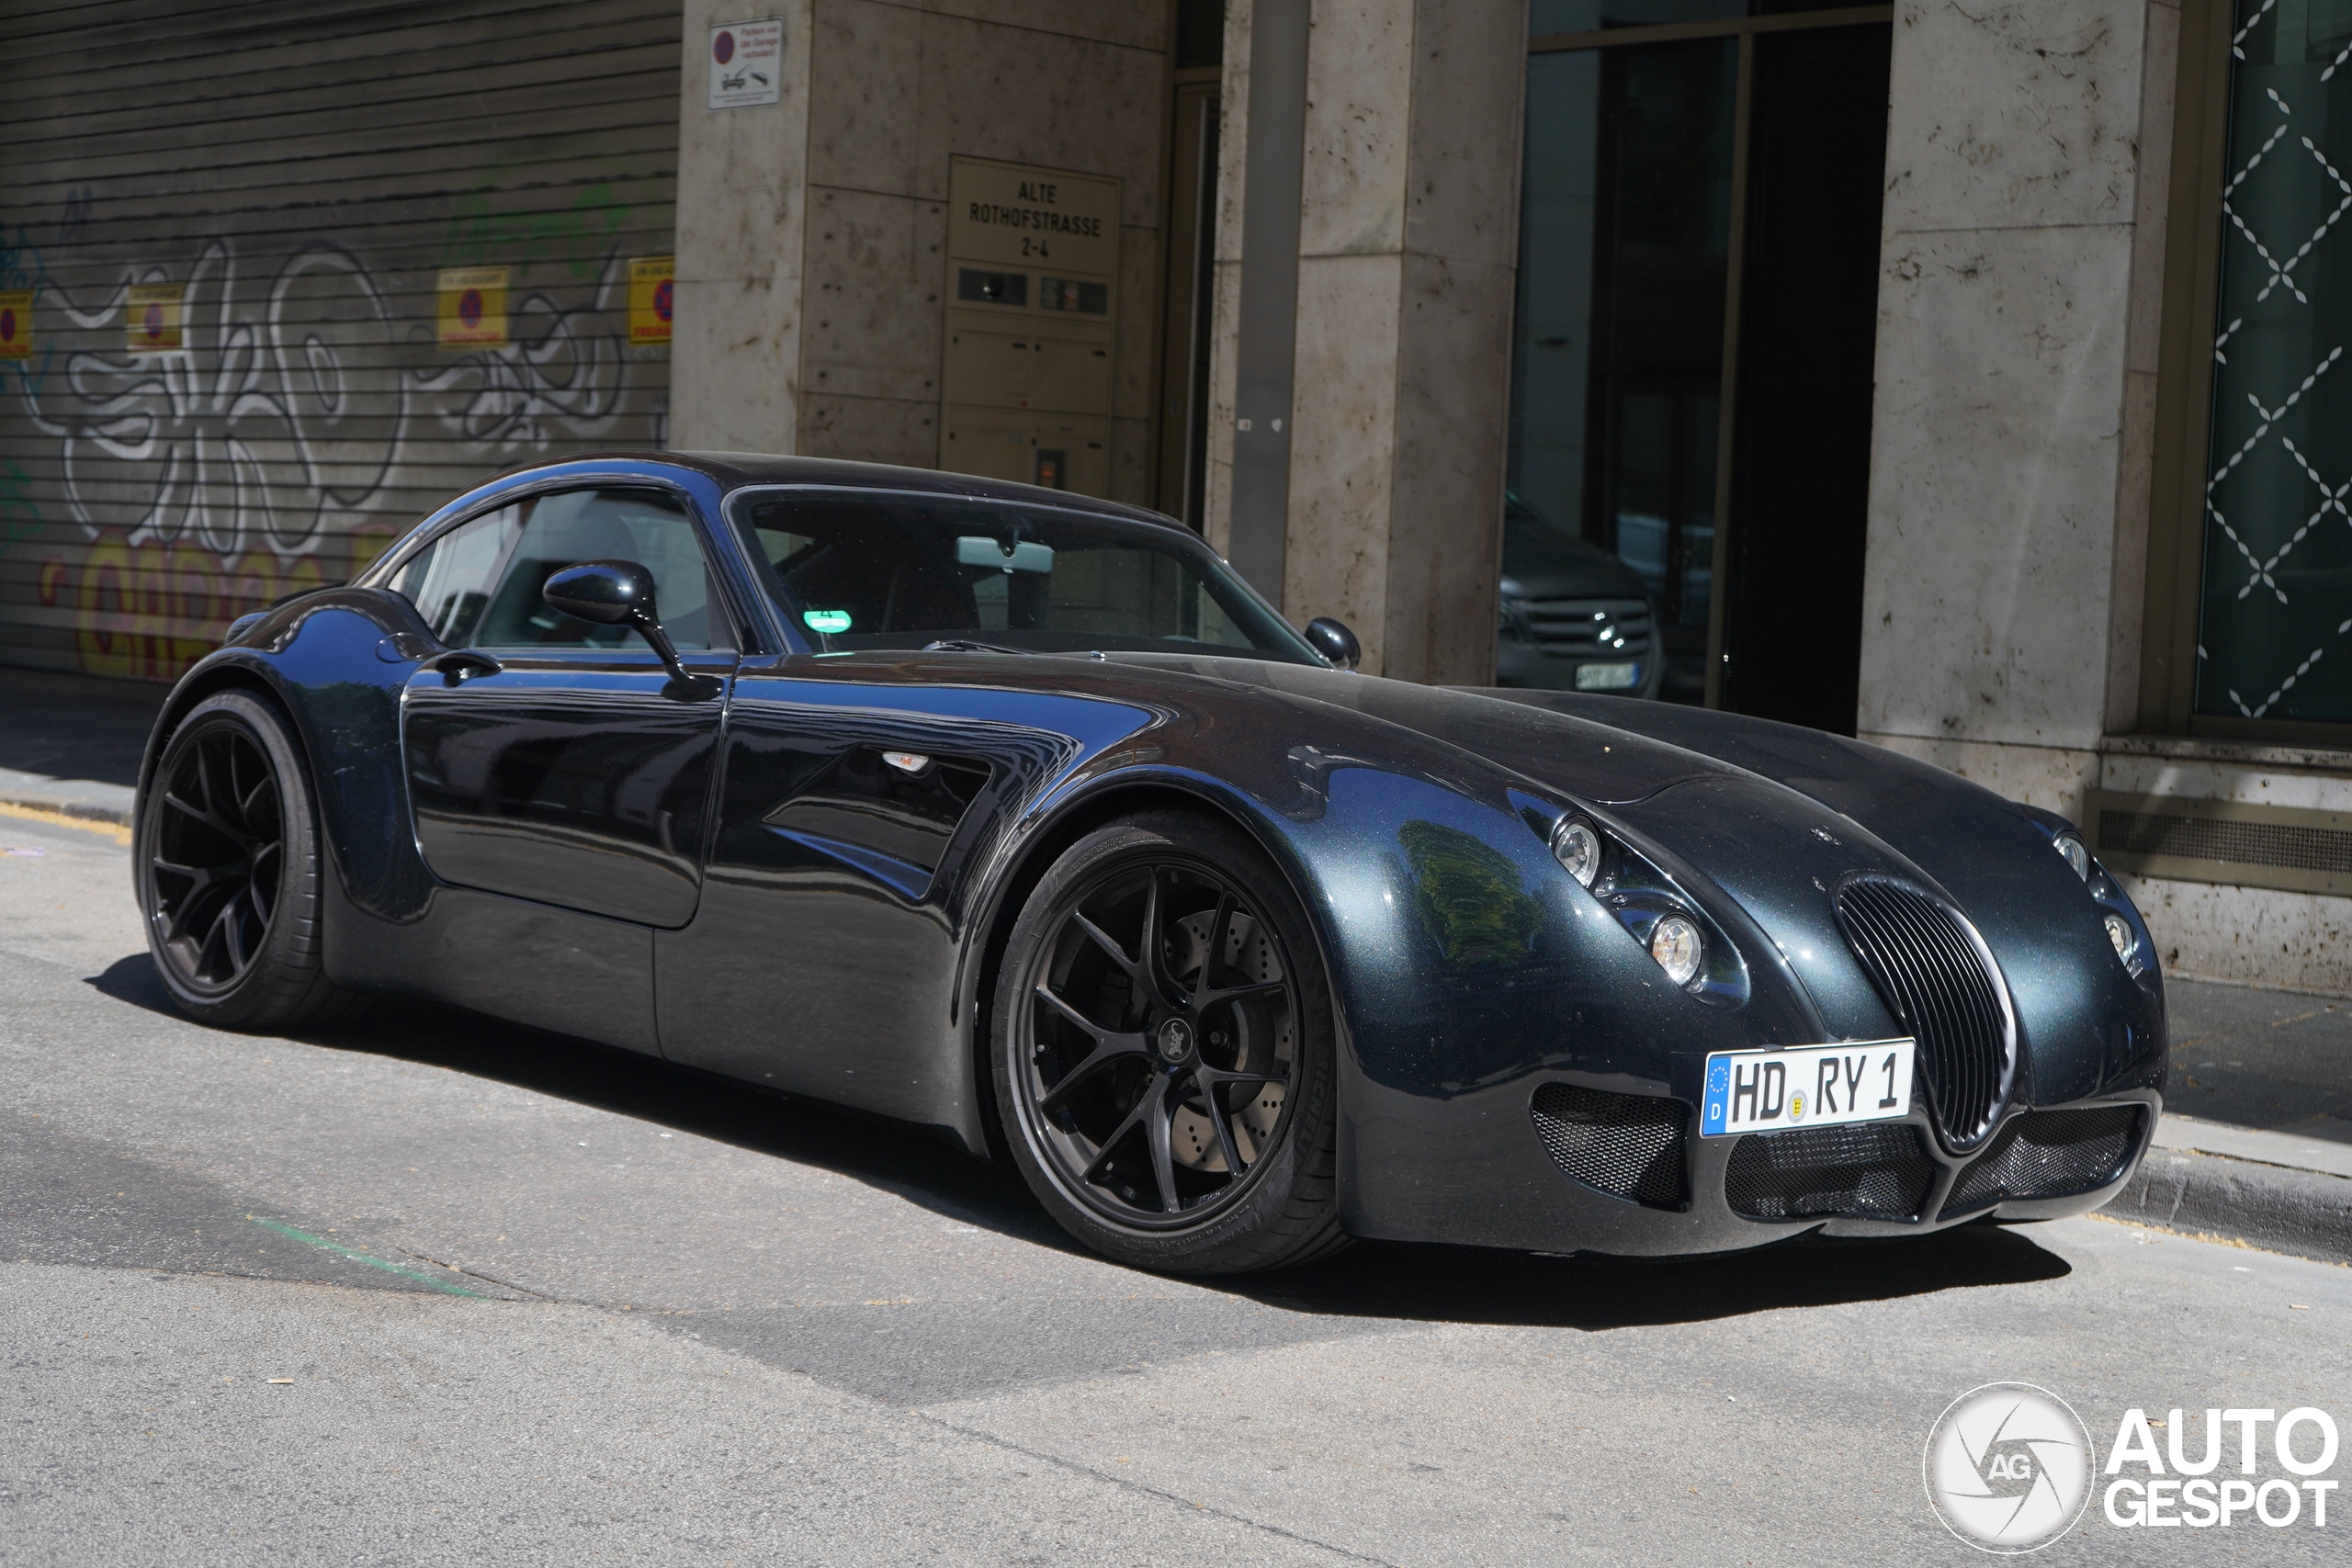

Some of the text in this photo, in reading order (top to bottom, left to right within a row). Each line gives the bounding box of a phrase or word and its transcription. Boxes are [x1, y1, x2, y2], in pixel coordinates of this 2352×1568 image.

[752, 38, 778, 48] Garage
[1017, 181, 1057, 204] ALTE
[969, 202, 1102, 237] ROTHOFSTRASSE
[1022, 236, 1049, 258] 2-4
[1732, 1061, 1786, 1122] HD
[1815, 1055, 1867, 1115] RY
[1879, 1053, 1898, 1109] 1
[1287, 1043, 1329, 1173] MICHELIN
[1711, 1103, 1721, 1121] D
